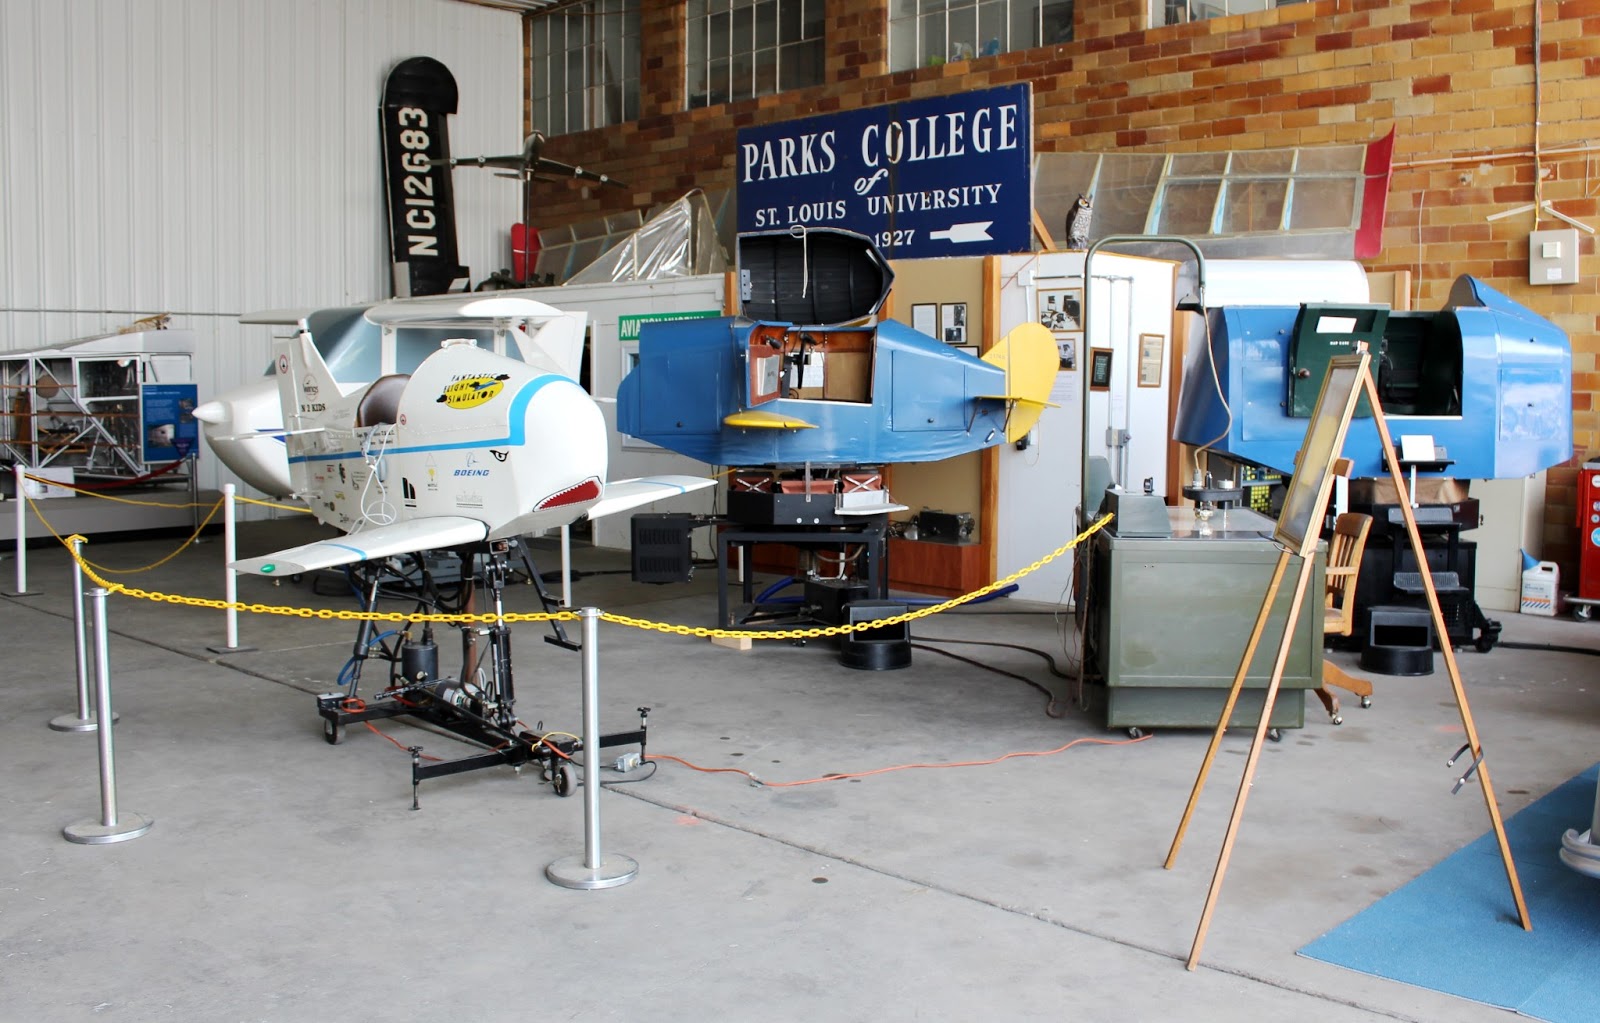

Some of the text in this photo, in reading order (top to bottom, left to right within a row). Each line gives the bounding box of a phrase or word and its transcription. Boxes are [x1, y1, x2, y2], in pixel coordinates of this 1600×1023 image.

[741, 104, 1018, 184] PARKS COLLEGE
[854, 168, 889, 196] of
[755, 183, 1002, 228] ST. LOUIS UNIVERSITY
[873, 229, 916, 249] 1927
[443, 382, 470, 394] FLIGHT
[447, 390, 494, 404] SIMULATOR
[311, 403, 326, 412] KIDS
[453, 469, 490, 477] BOEING
